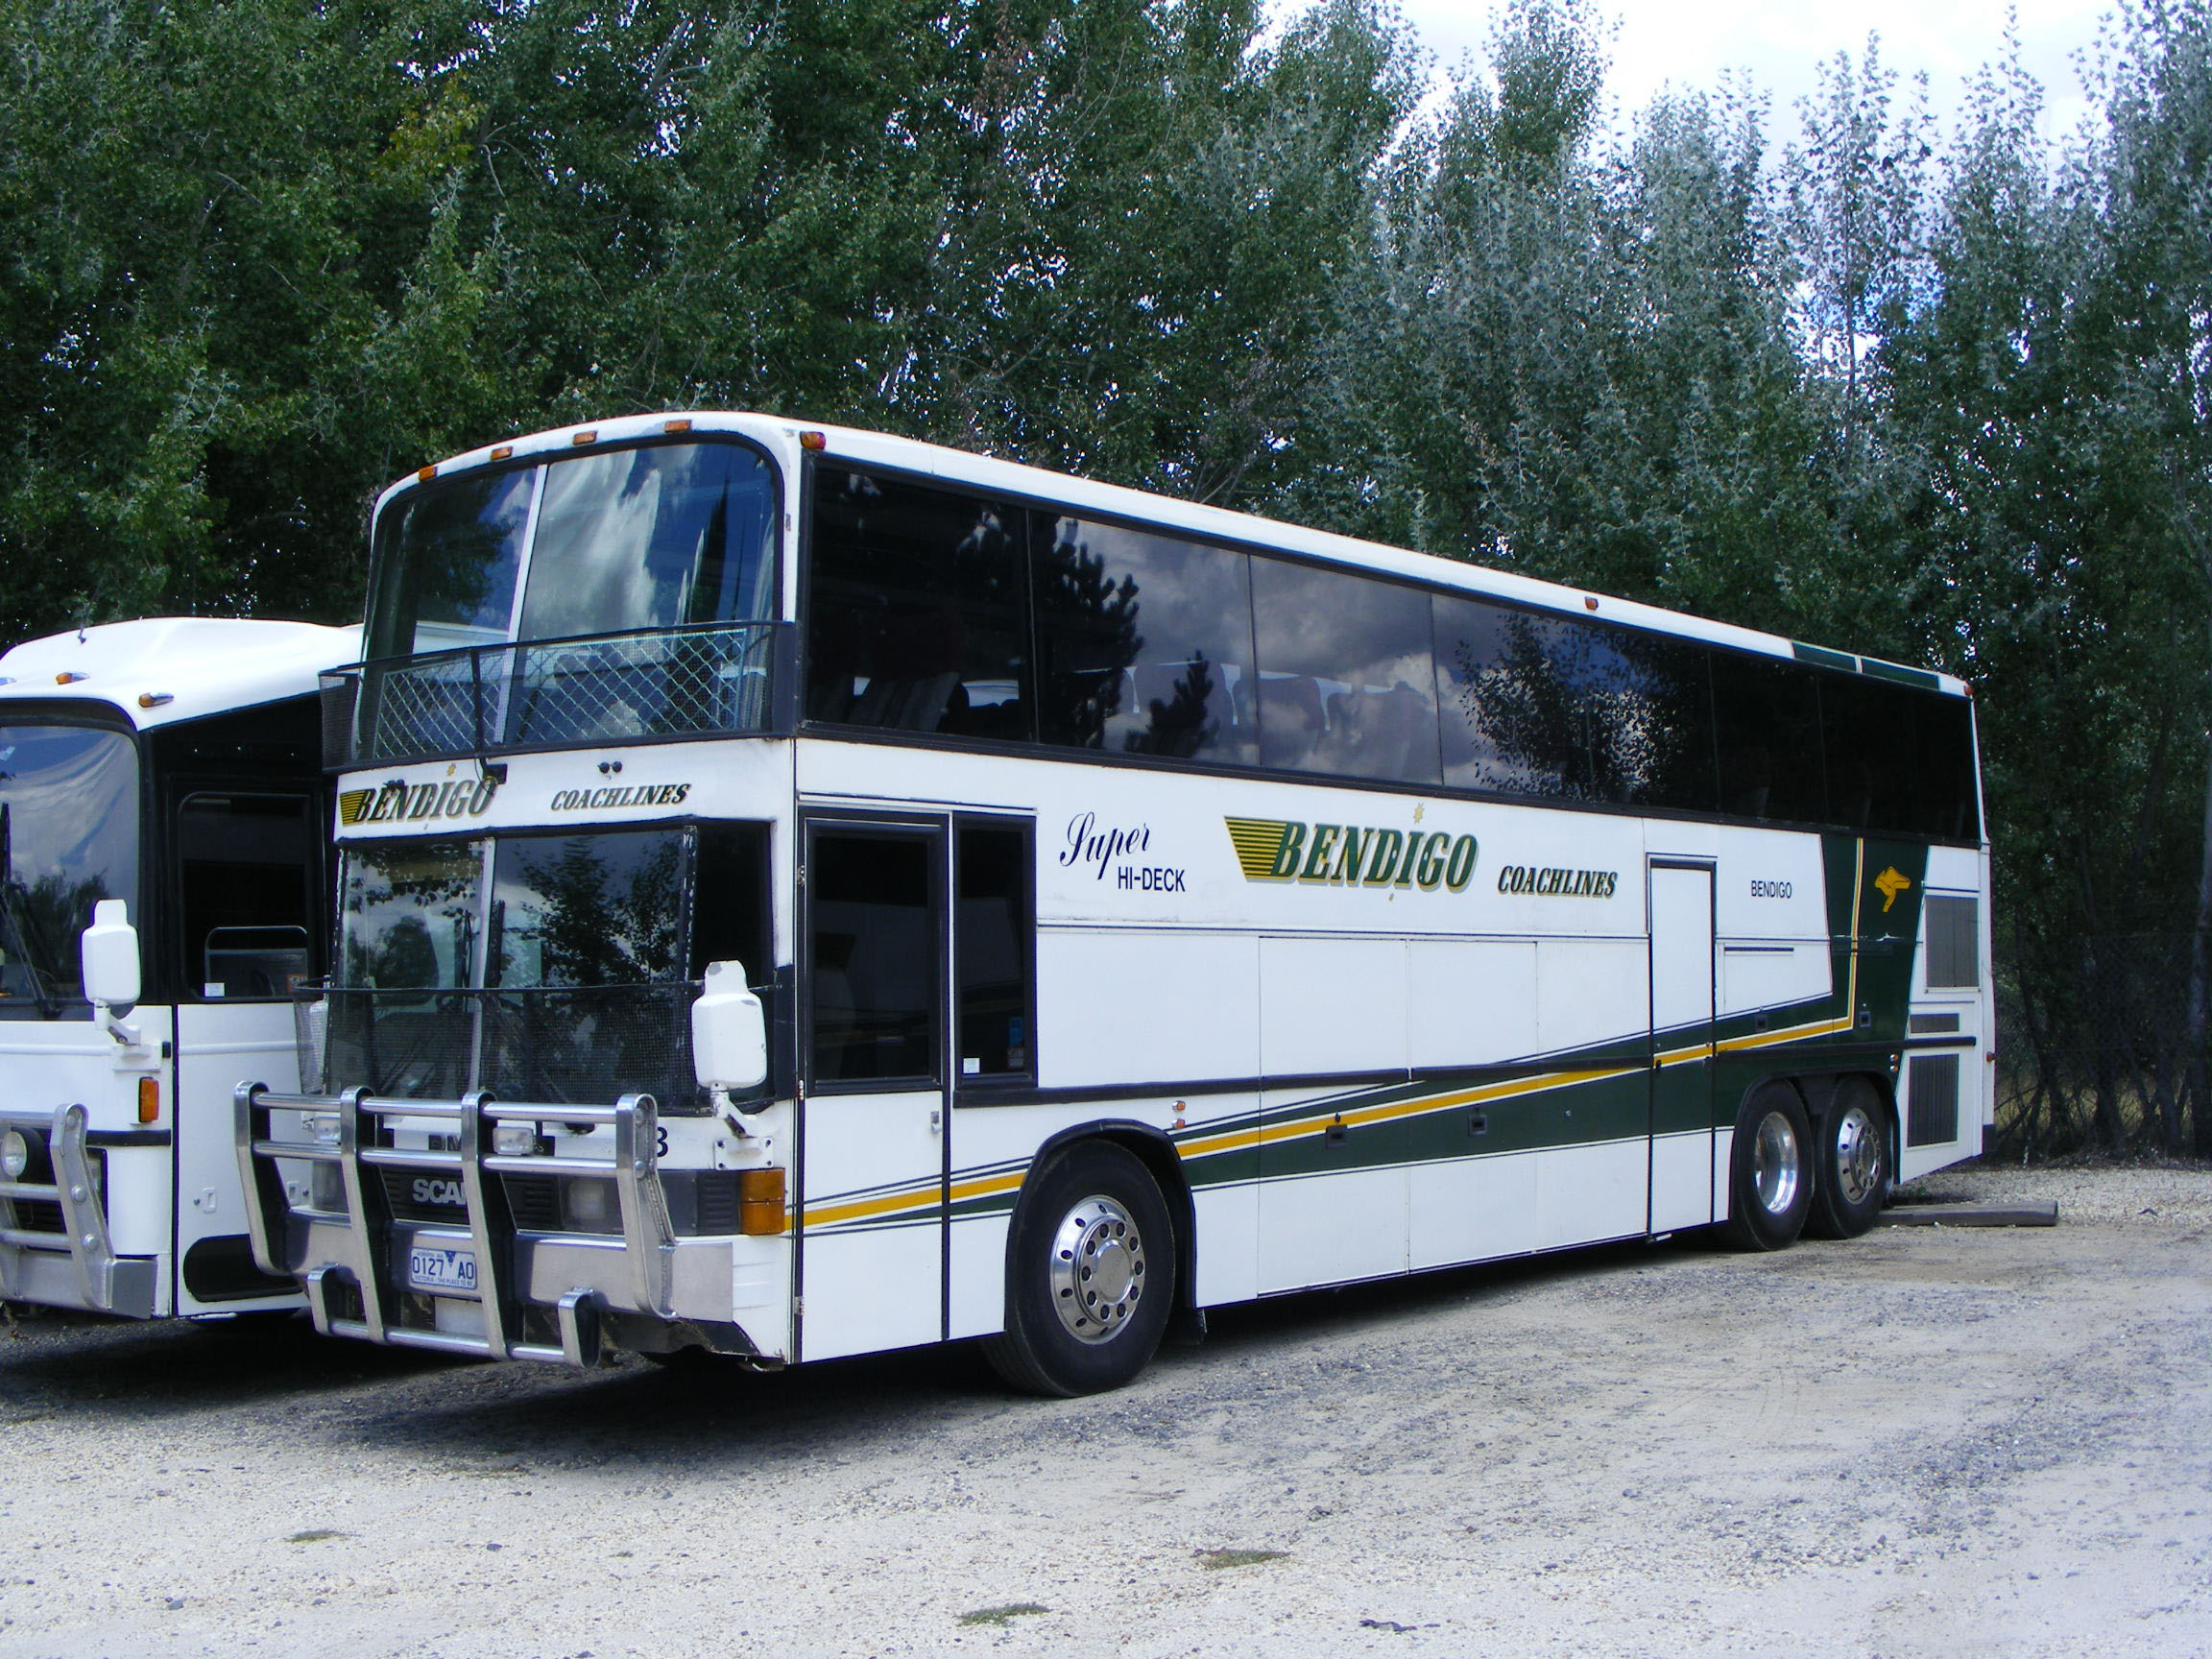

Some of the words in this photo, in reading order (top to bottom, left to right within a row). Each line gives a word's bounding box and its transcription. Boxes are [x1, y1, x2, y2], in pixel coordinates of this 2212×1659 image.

[354, 778, 497, 823] BENDIGO
[550, 782, 692, 811] COACHLINES
[1059, 810, 1151, 880] Super
[1269, 820, 1478, 891] BENDIGO
[1497, 864, 1619, 899] COACHLINES
[1117, 866, 1187, 893] HI-DECK
[1750, 879, 1792, 900] BENDIGO
[412, 1256, 445, 1277] 0127
